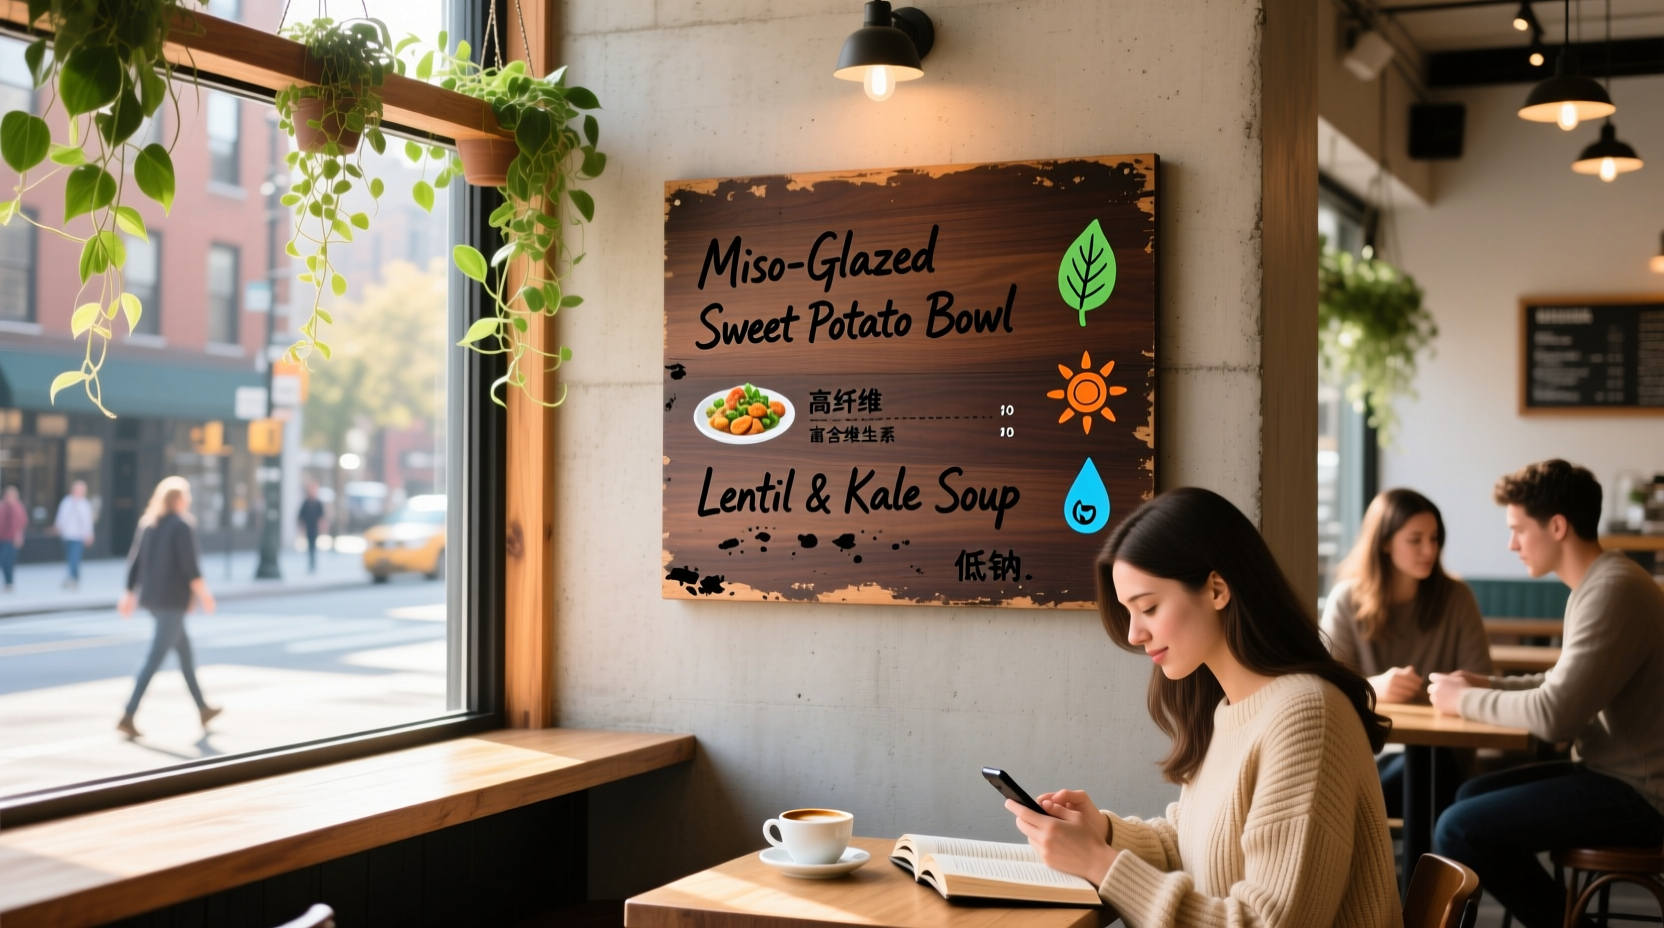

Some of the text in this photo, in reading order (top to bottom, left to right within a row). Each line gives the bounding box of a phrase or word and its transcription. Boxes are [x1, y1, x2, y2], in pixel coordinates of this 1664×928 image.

[697, 224, 939, 293] Miso-Glazed
[695, 283, 1017, 350] Sweet Potato Bowl
[809, 388, 882, 414] 高纤维
[1000, 404, 1014, 416] 10
[697, 466, 1020, 530] Lentil & Kale Soup
